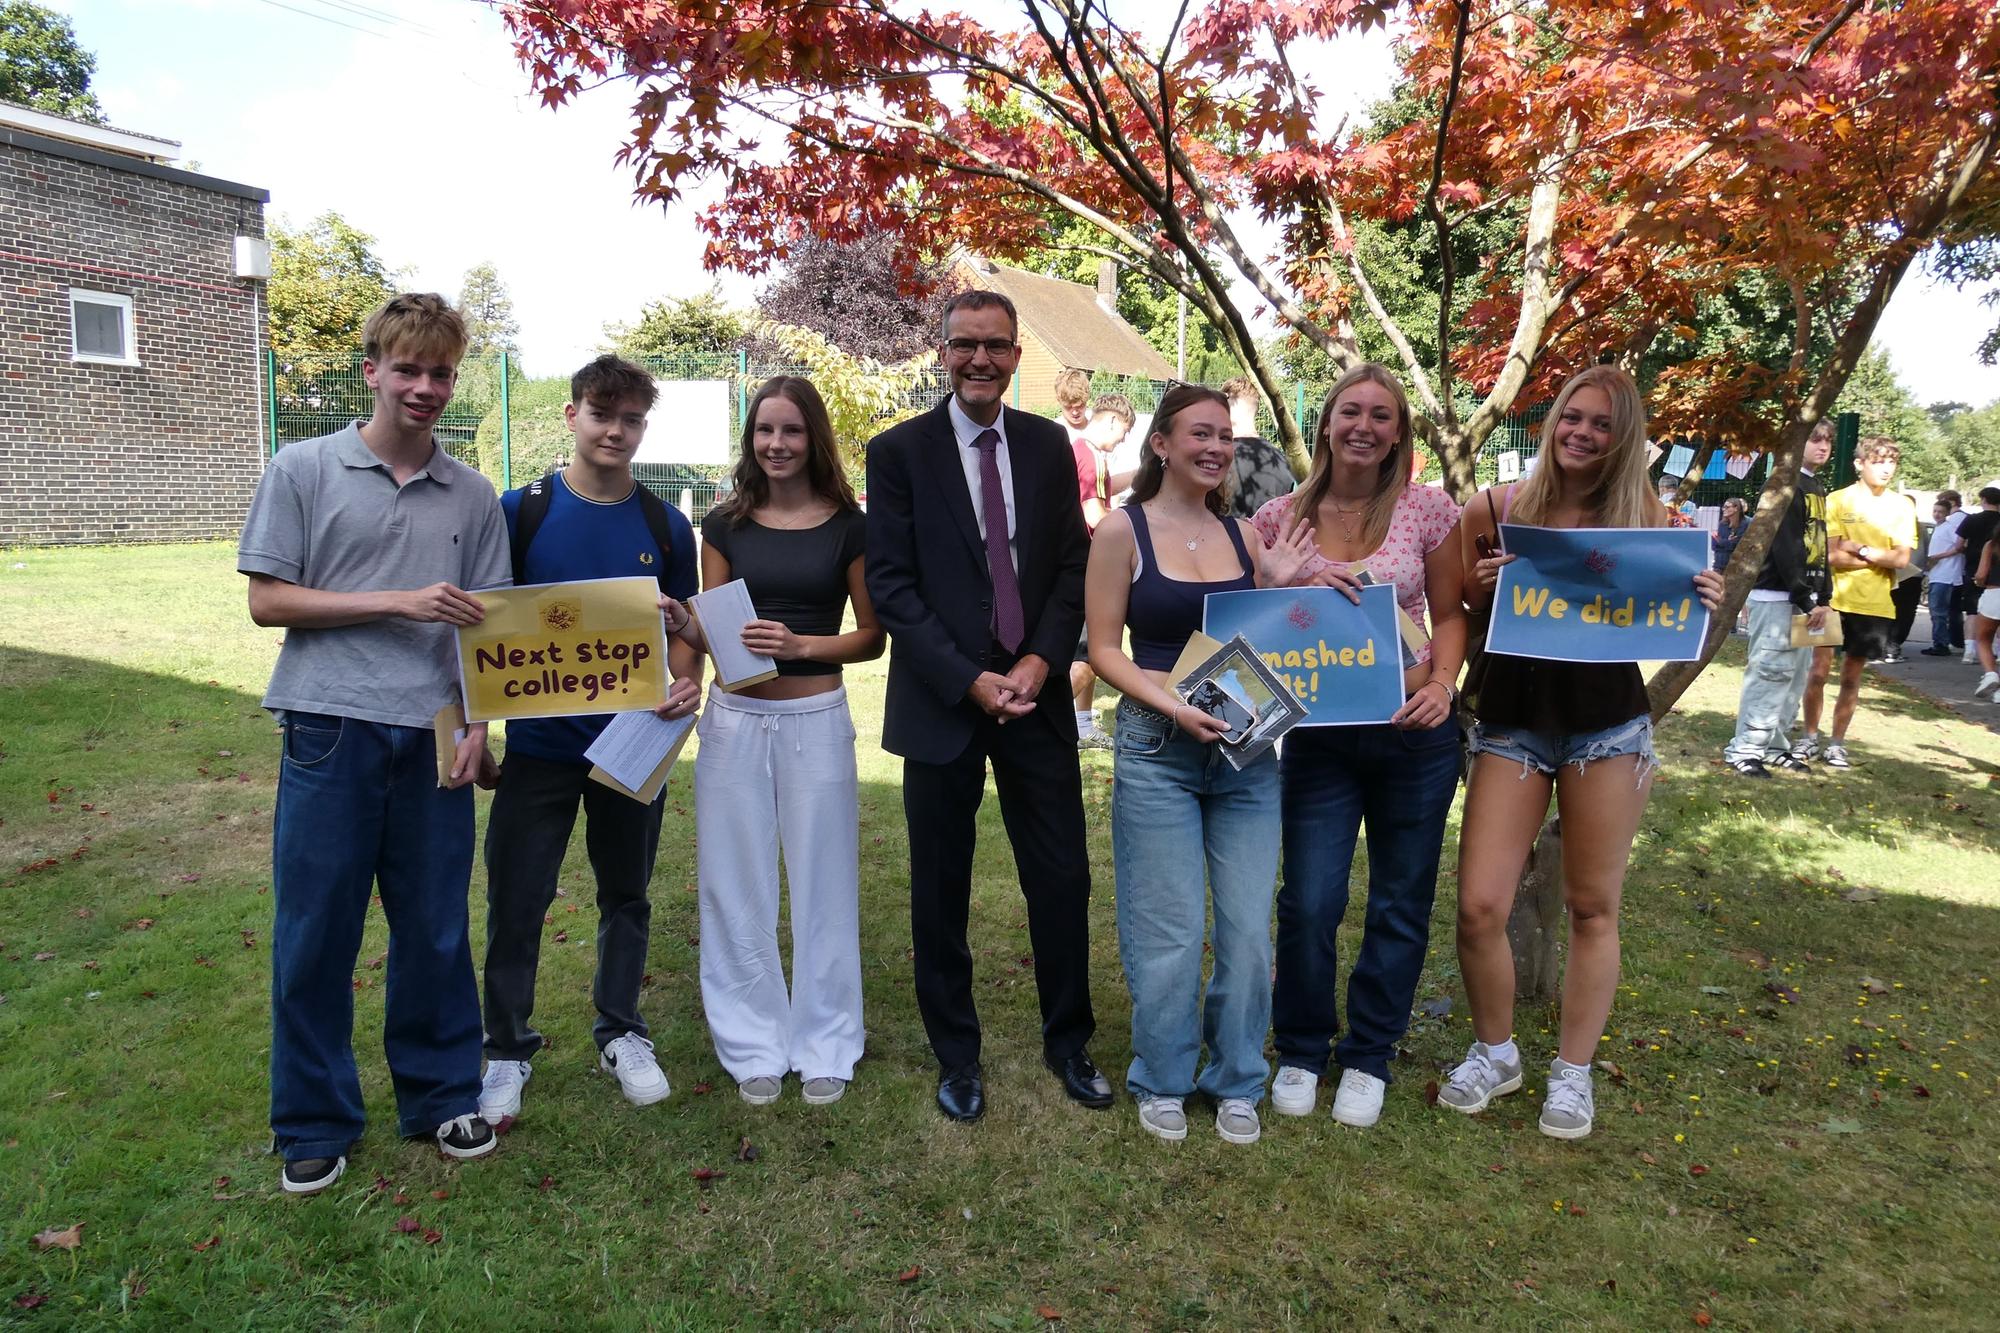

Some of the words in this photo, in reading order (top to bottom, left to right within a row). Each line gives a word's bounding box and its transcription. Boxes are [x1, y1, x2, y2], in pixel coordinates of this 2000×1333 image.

[1513, 584, 1569, 619] We
[1580, 594, 1635, 628] did
[1646, 598, 1692, 632] it!
[476, 642, 564, 673] Next
[576, 638, 650, 669] stop
[1261, 638, 1375, 669] mashed
[504, 663, 629, 702] college!
